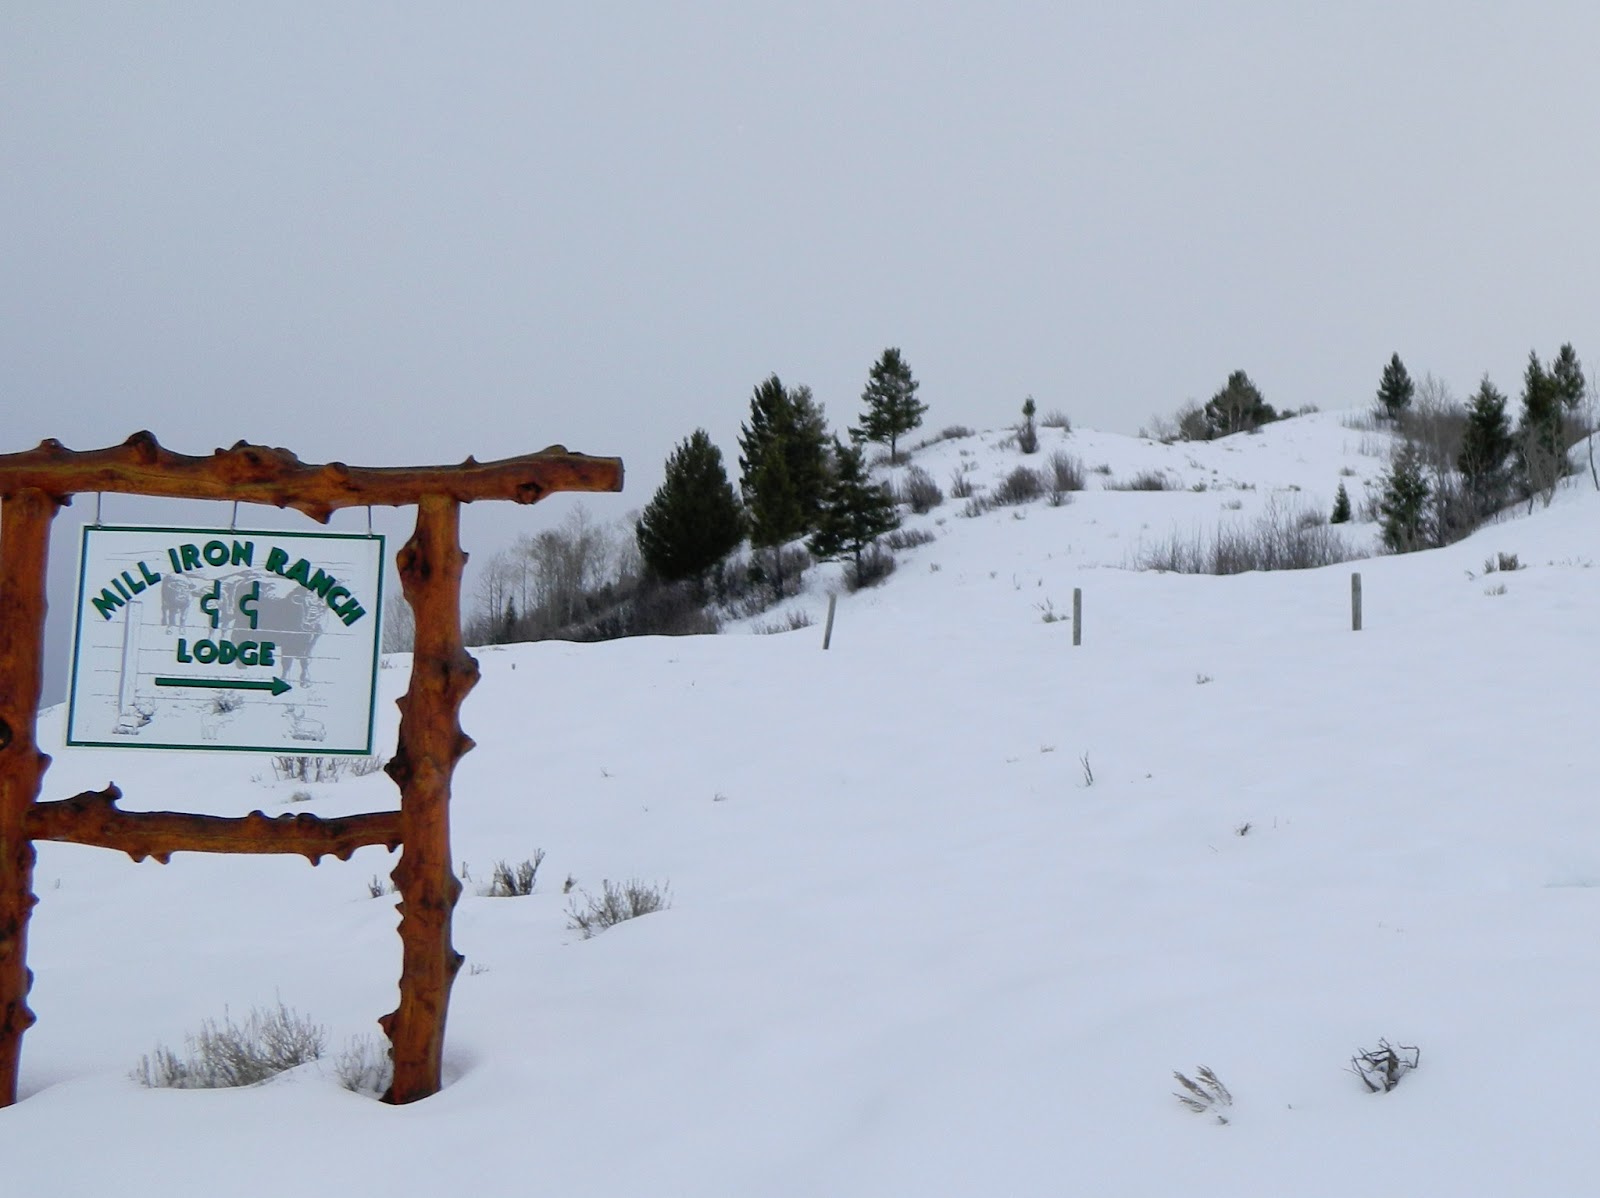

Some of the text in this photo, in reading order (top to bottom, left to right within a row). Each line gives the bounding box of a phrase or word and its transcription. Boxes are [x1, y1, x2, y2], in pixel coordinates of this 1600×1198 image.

[92, 540, 367, 627] MILL IRON RANCH
[177, 638, 275, 666] LODGE
